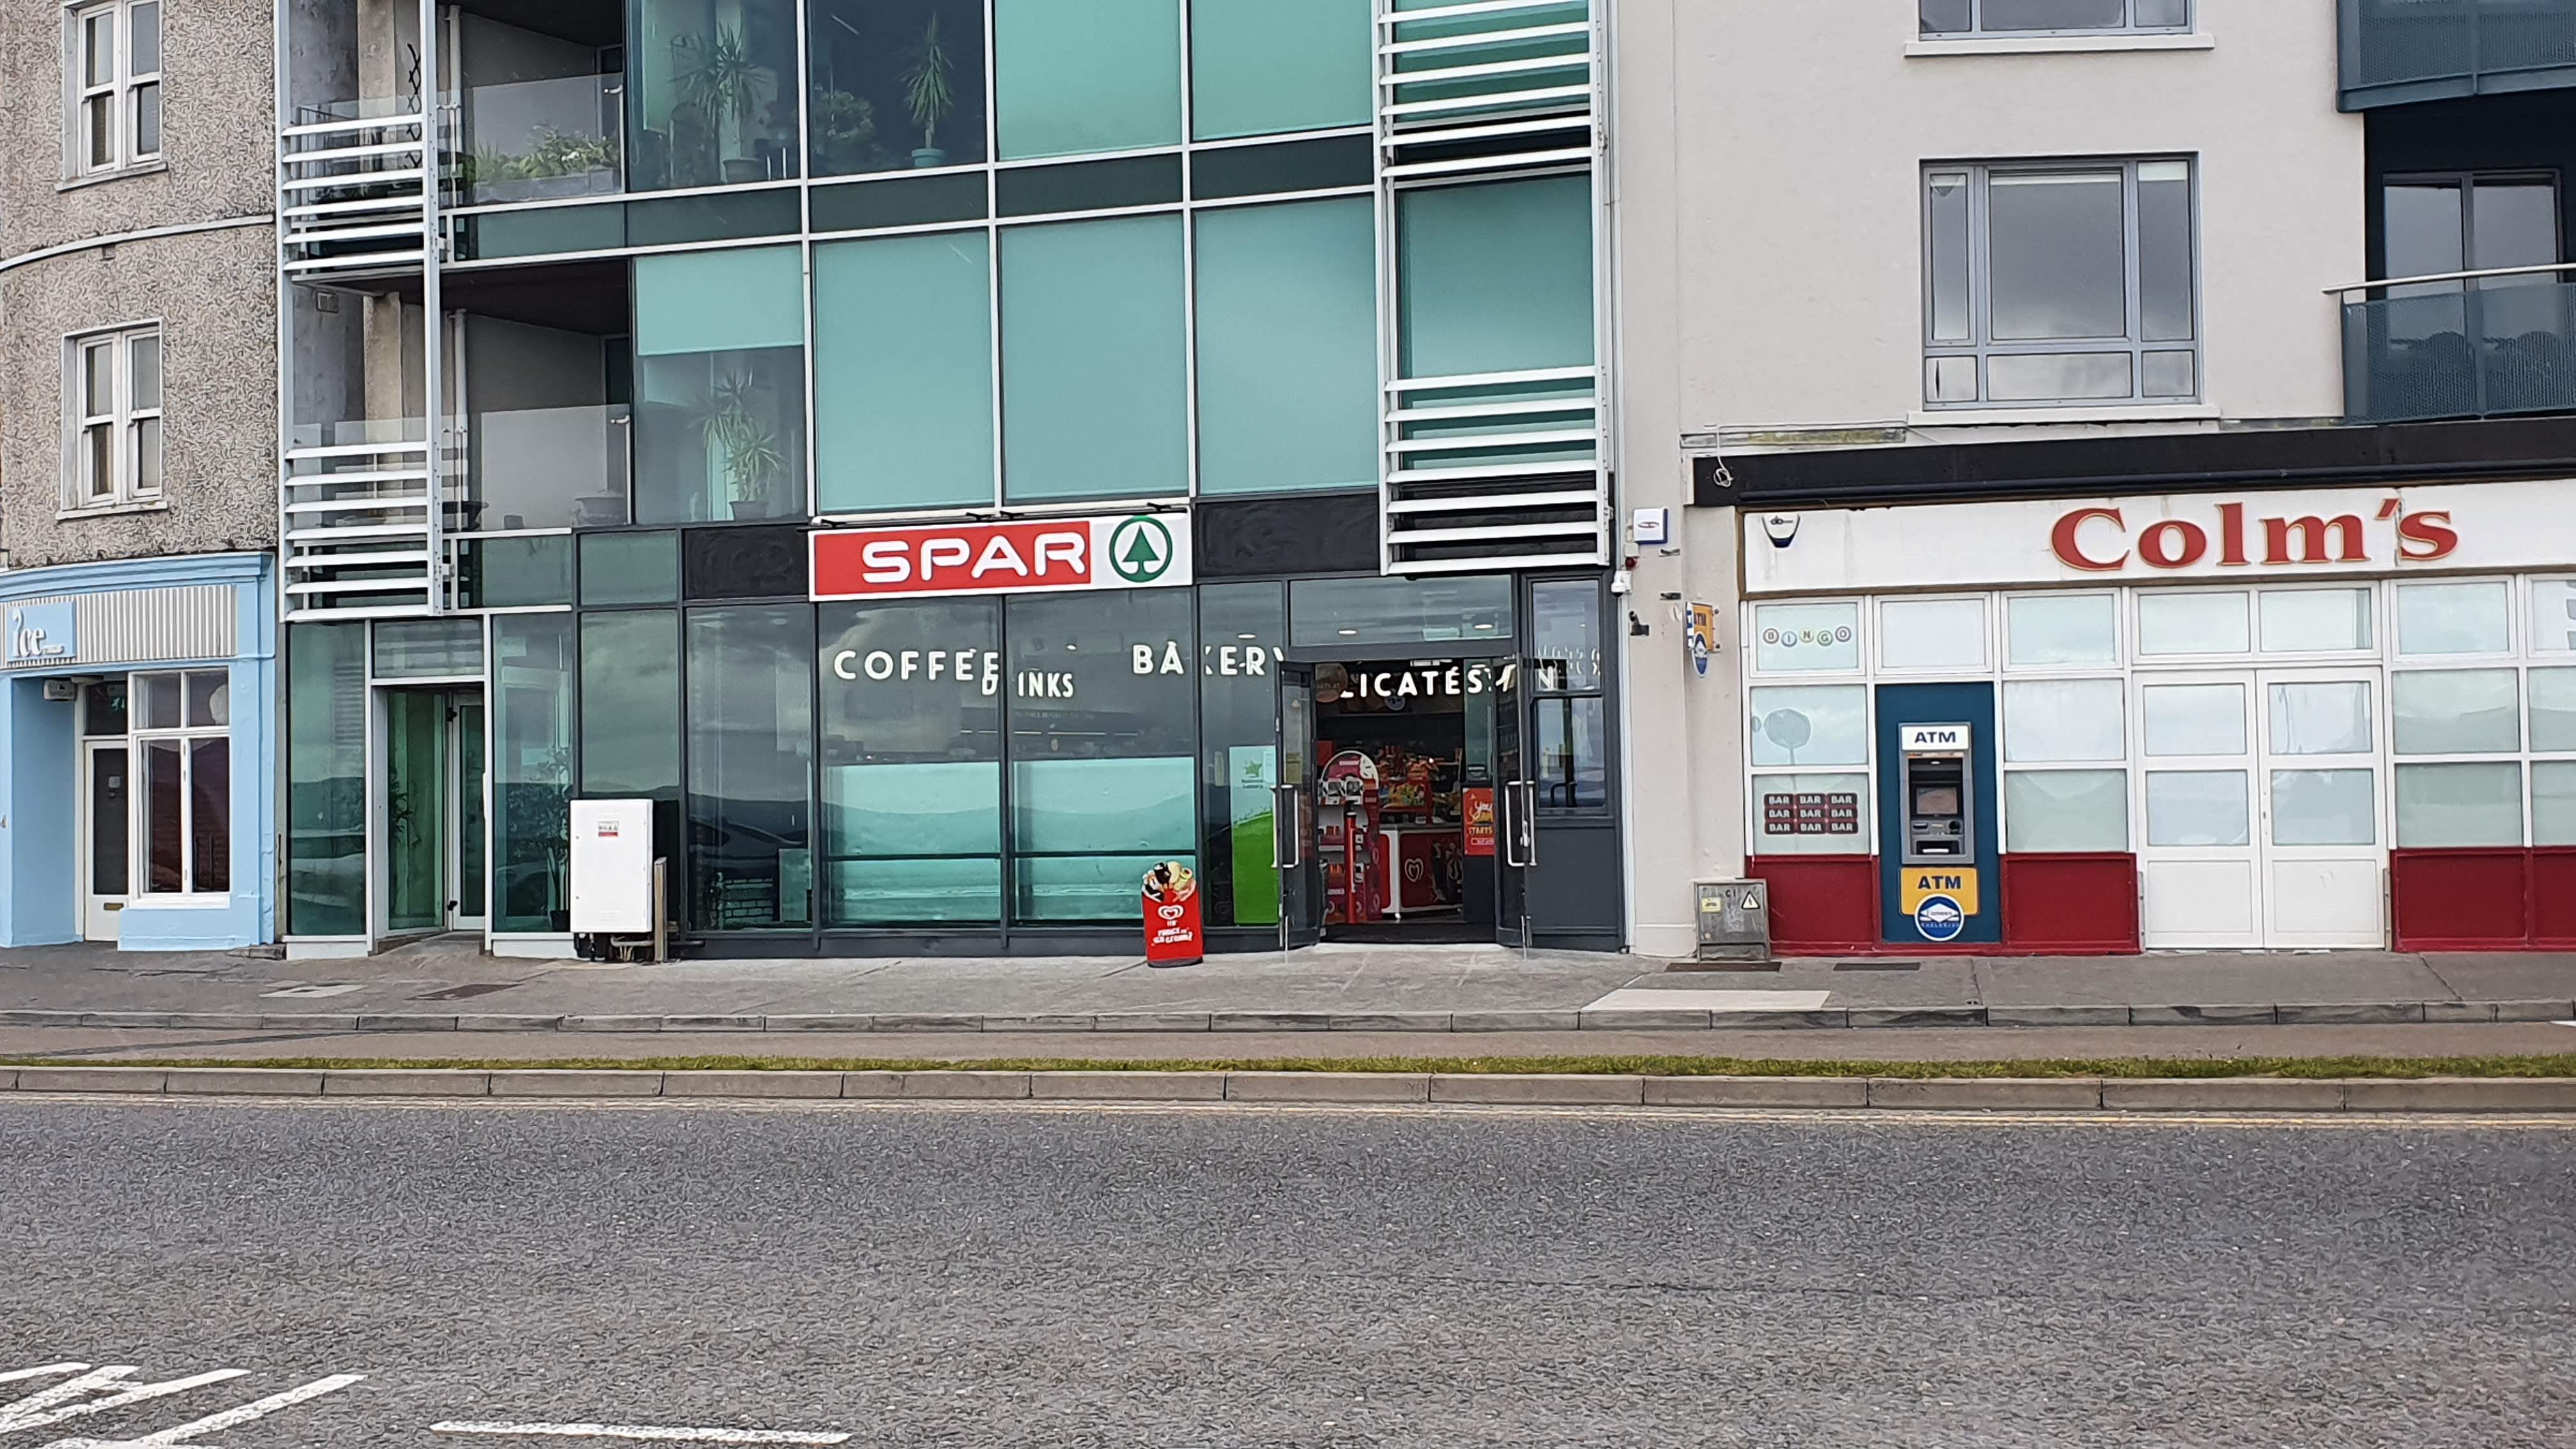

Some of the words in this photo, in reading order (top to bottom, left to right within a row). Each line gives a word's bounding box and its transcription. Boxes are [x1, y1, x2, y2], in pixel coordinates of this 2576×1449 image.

[2051, 498, 2459, 571] Colm's
[862, 532, 1086, 583] SPAR
[1766, 629, 1848, 644] BINGO
[834, 650, 999, 680] COFFEE
[1133, 644, 1284, 675] BAER
[981, 671, 1074, 698] DINKS
[1914, 732, 1956, 743] ATM
[1769, 796, 1790, 804] BAR
[1831, 795, 1852, 804] BAR
[1769, 809, 1790, 818] BAR
[1800, 809, 1821, 818] BAR
[1831, 809, 1853, 817] BAR
[1917, 875, 1961, 889] ATM
